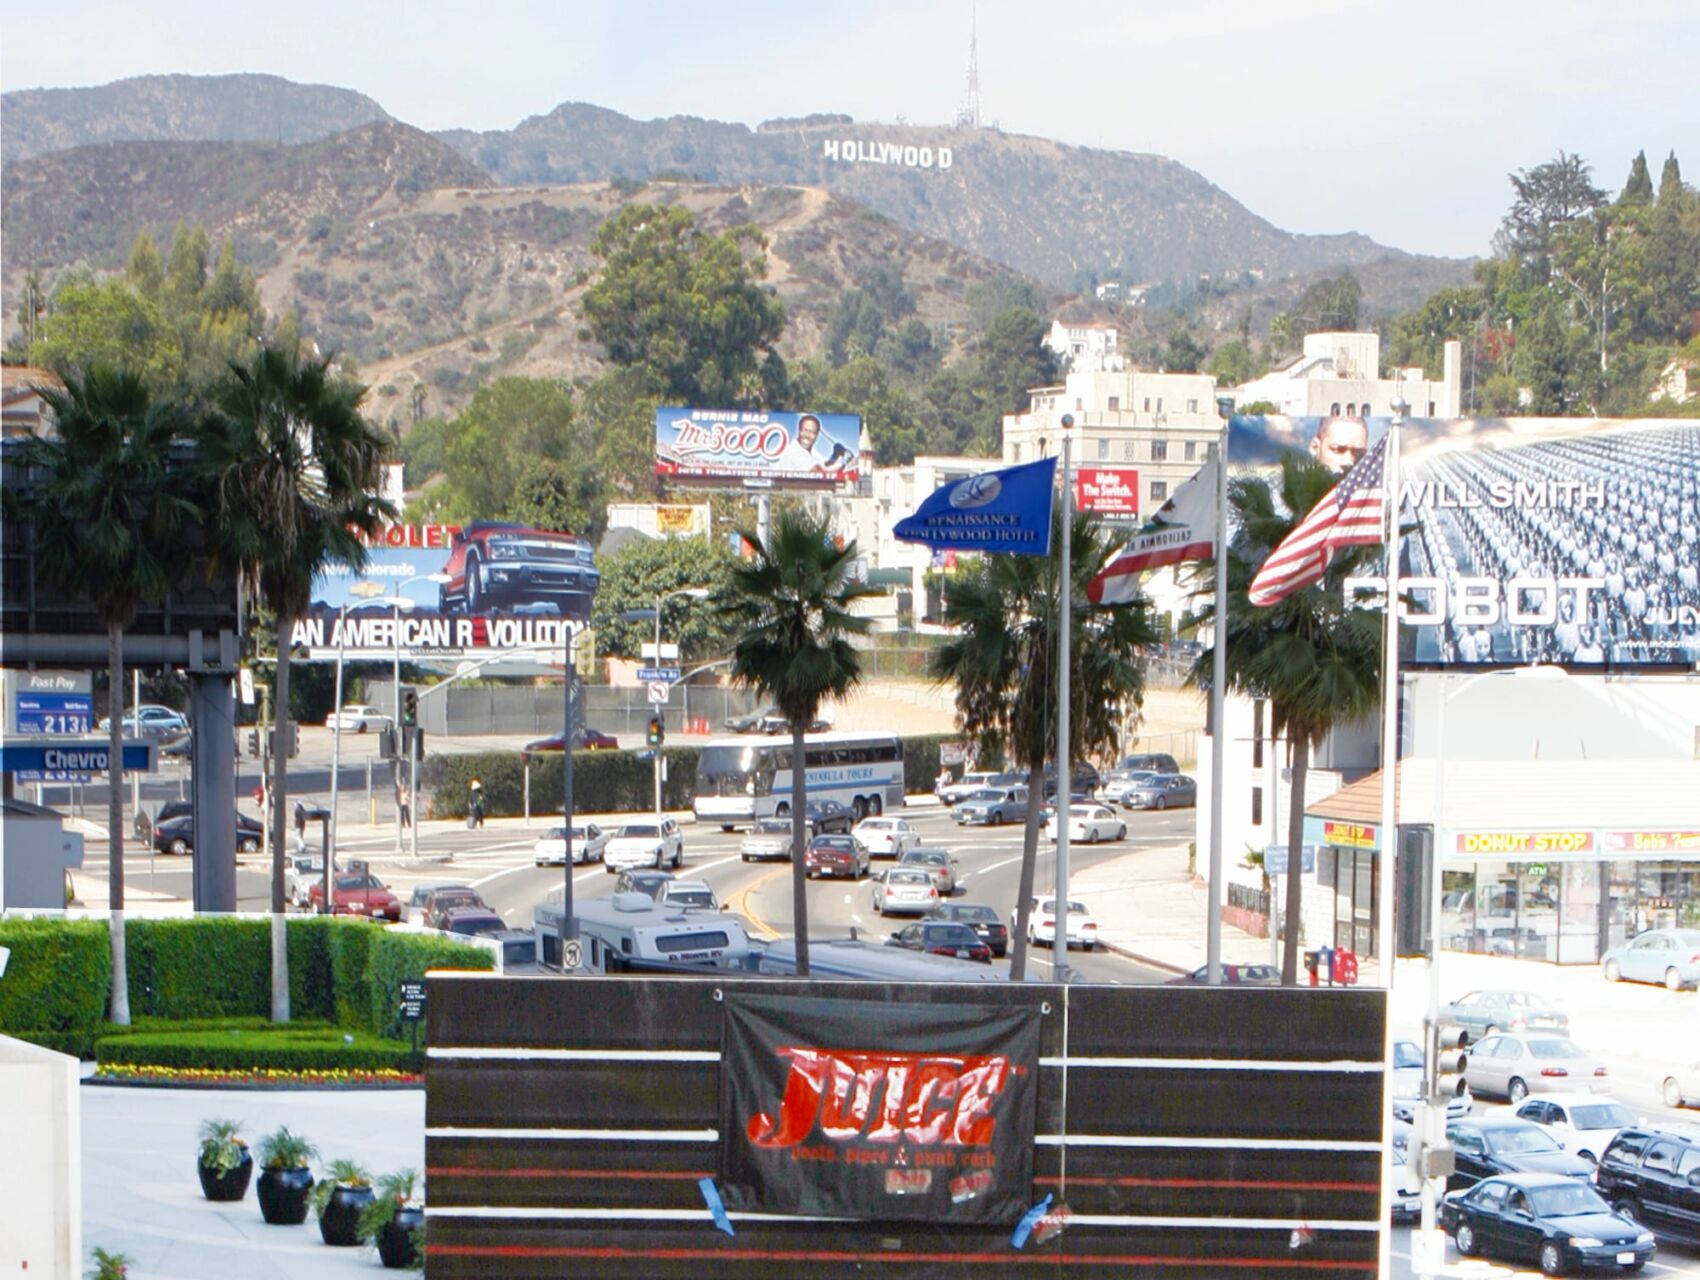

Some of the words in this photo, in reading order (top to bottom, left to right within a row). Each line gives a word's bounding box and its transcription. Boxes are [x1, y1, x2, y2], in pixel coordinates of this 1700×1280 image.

[824, 139, 952, 169] HOLLYWOOD
[691, 411, 739, 423] BERNIE
[741, 413, 769, 423] MAC
[1083, 483, 1100, 497] The
[1388, 482, 1481, 508] WILL
[1489, 482, 1605, 508] SMITH
[928, 514, 1019, 526] RENAISSANCE
[995, 530, 1036, 542] HOTEL
[291, 619, 324, 646] AN
[330, 619, 450, 646] AMERICAN
[30, 676, 53, 688] Fast
[55, 677, 76, 690] Pay
[45, 750, 109, 769] Chevro
[1464, 833, 1530, 852] DONUT
[1534, 833, 1587, 851] STOP
[1528, 865, 1547, 876] ATM
[747, 1046, 1008, 1149] JUICE
